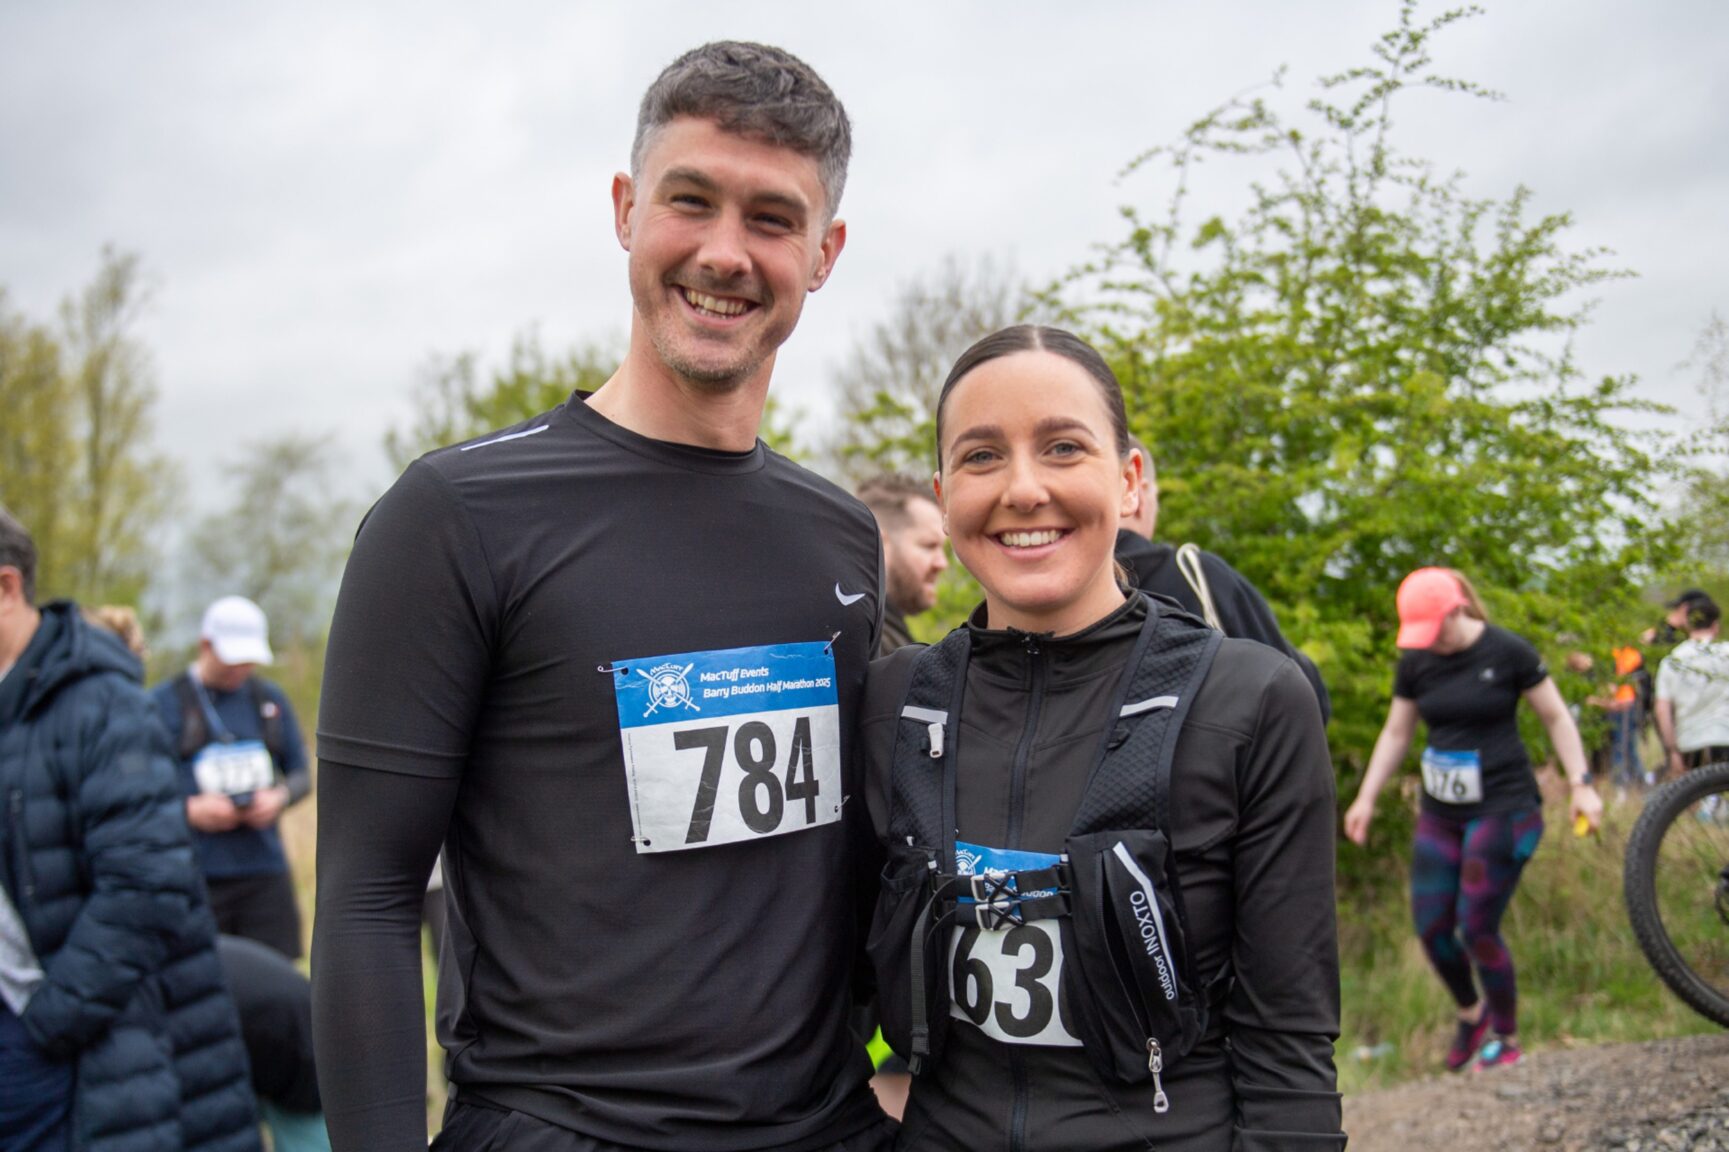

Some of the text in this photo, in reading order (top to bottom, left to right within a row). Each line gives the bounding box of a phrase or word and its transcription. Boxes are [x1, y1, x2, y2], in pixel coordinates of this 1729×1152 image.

[700, 666, 769, 682] MacTuff Events
[703, 686, 729, 699] Barry
[731, 682, 765, 696] Buddon
[766, 679, 782, 694] Half
[782, 678, 815, 691] Marathon
[673, 716, 819, 844] 784
[952, 924, 1082, 1038] 63
[1129, 890, 1176, 1001] outdoor INOXTO
